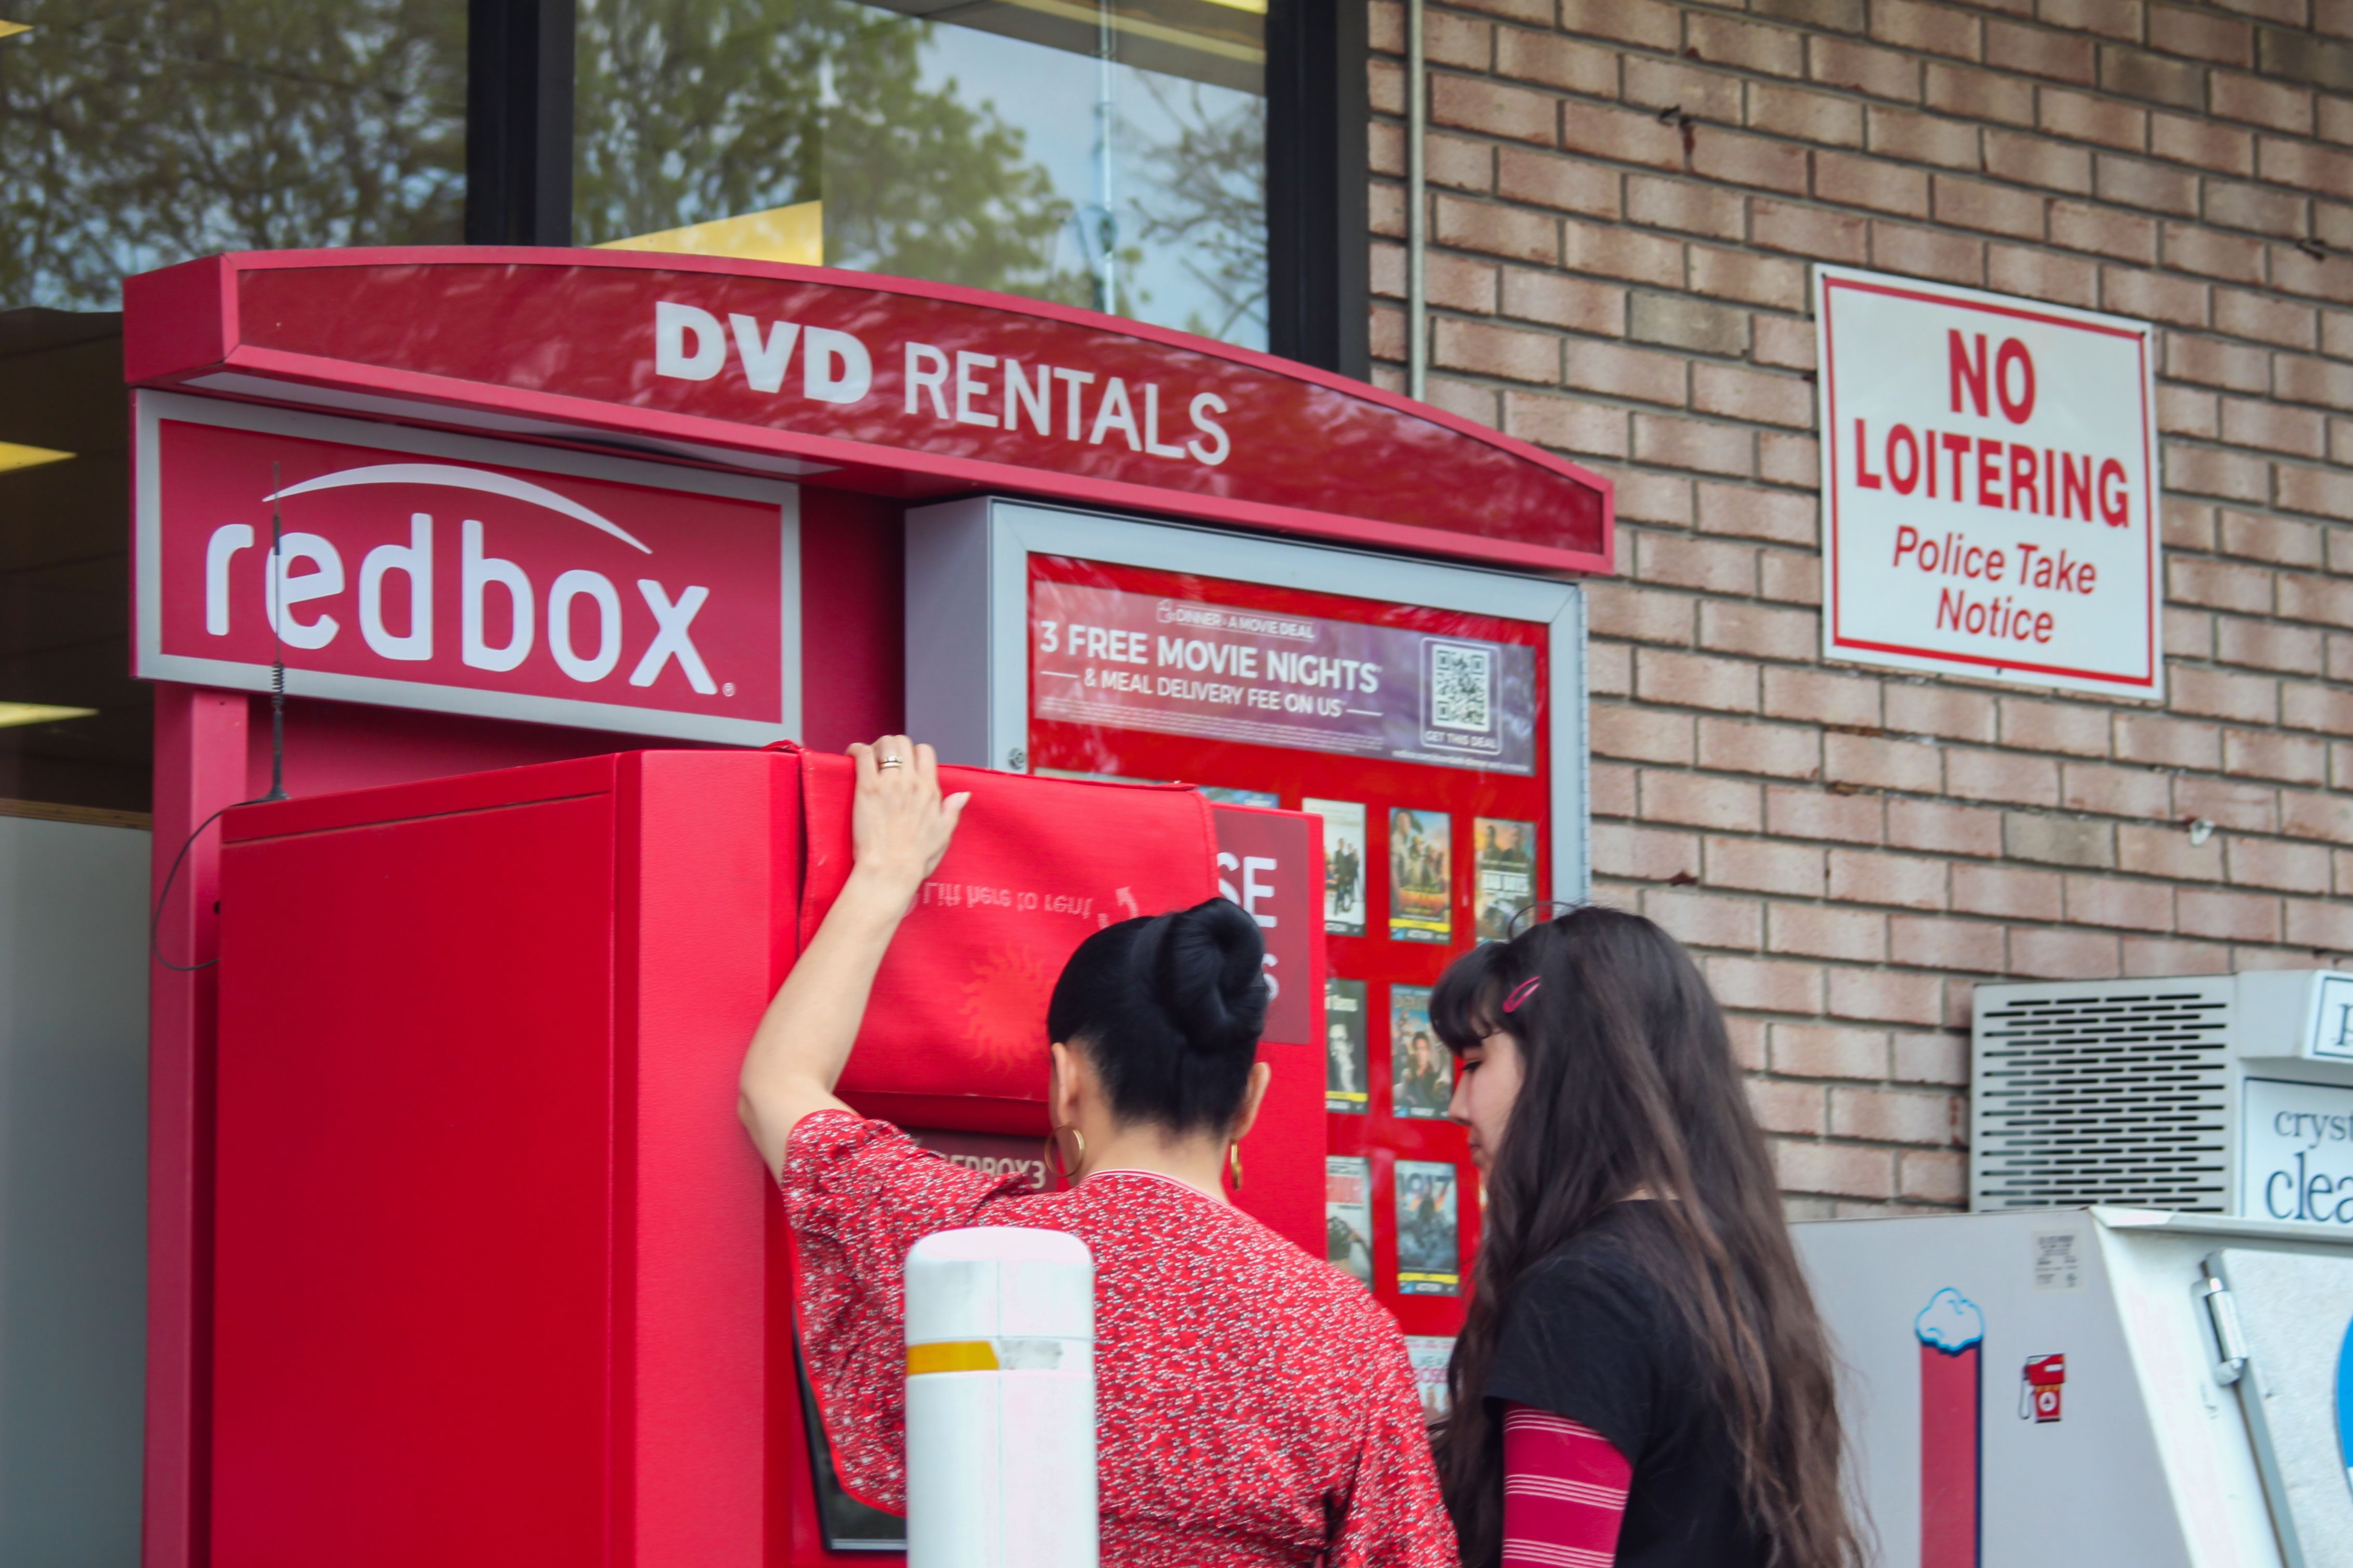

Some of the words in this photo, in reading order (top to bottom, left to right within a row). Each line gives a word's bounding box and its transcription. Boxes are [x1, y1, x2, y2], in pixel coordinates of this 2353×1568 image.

[656, 301, 872, 404] DVD
[905, 342, 1229, 466] RENTALS
[1948, 329, 2035, 424] NO
[1855, 418, 2129, 528] LOITERING
[1892, 524, 2005, 581] Police
[2017, 543, 2097, 594] Take
[206, 513, 718, 695] redbox
[1239, 618, 1278, 634] MOVIE
[1279, 622, 1315, 639] DEAL
[1937, 587, 2054, 643] Notice
[1040, 621, 1058, 652] 3
[1068, 624, 1149, 664] FREE
[1157, 635, 1259, 678] MOVIE
[1084, 668, 1096, 687] &
[1102, 670, 1153, 694] MEAL
[1158, 677, 1245, 705] DELIVERY
[1248, 688, 1281, 711] FEE
[1284, 693, 1314, 714] ON
